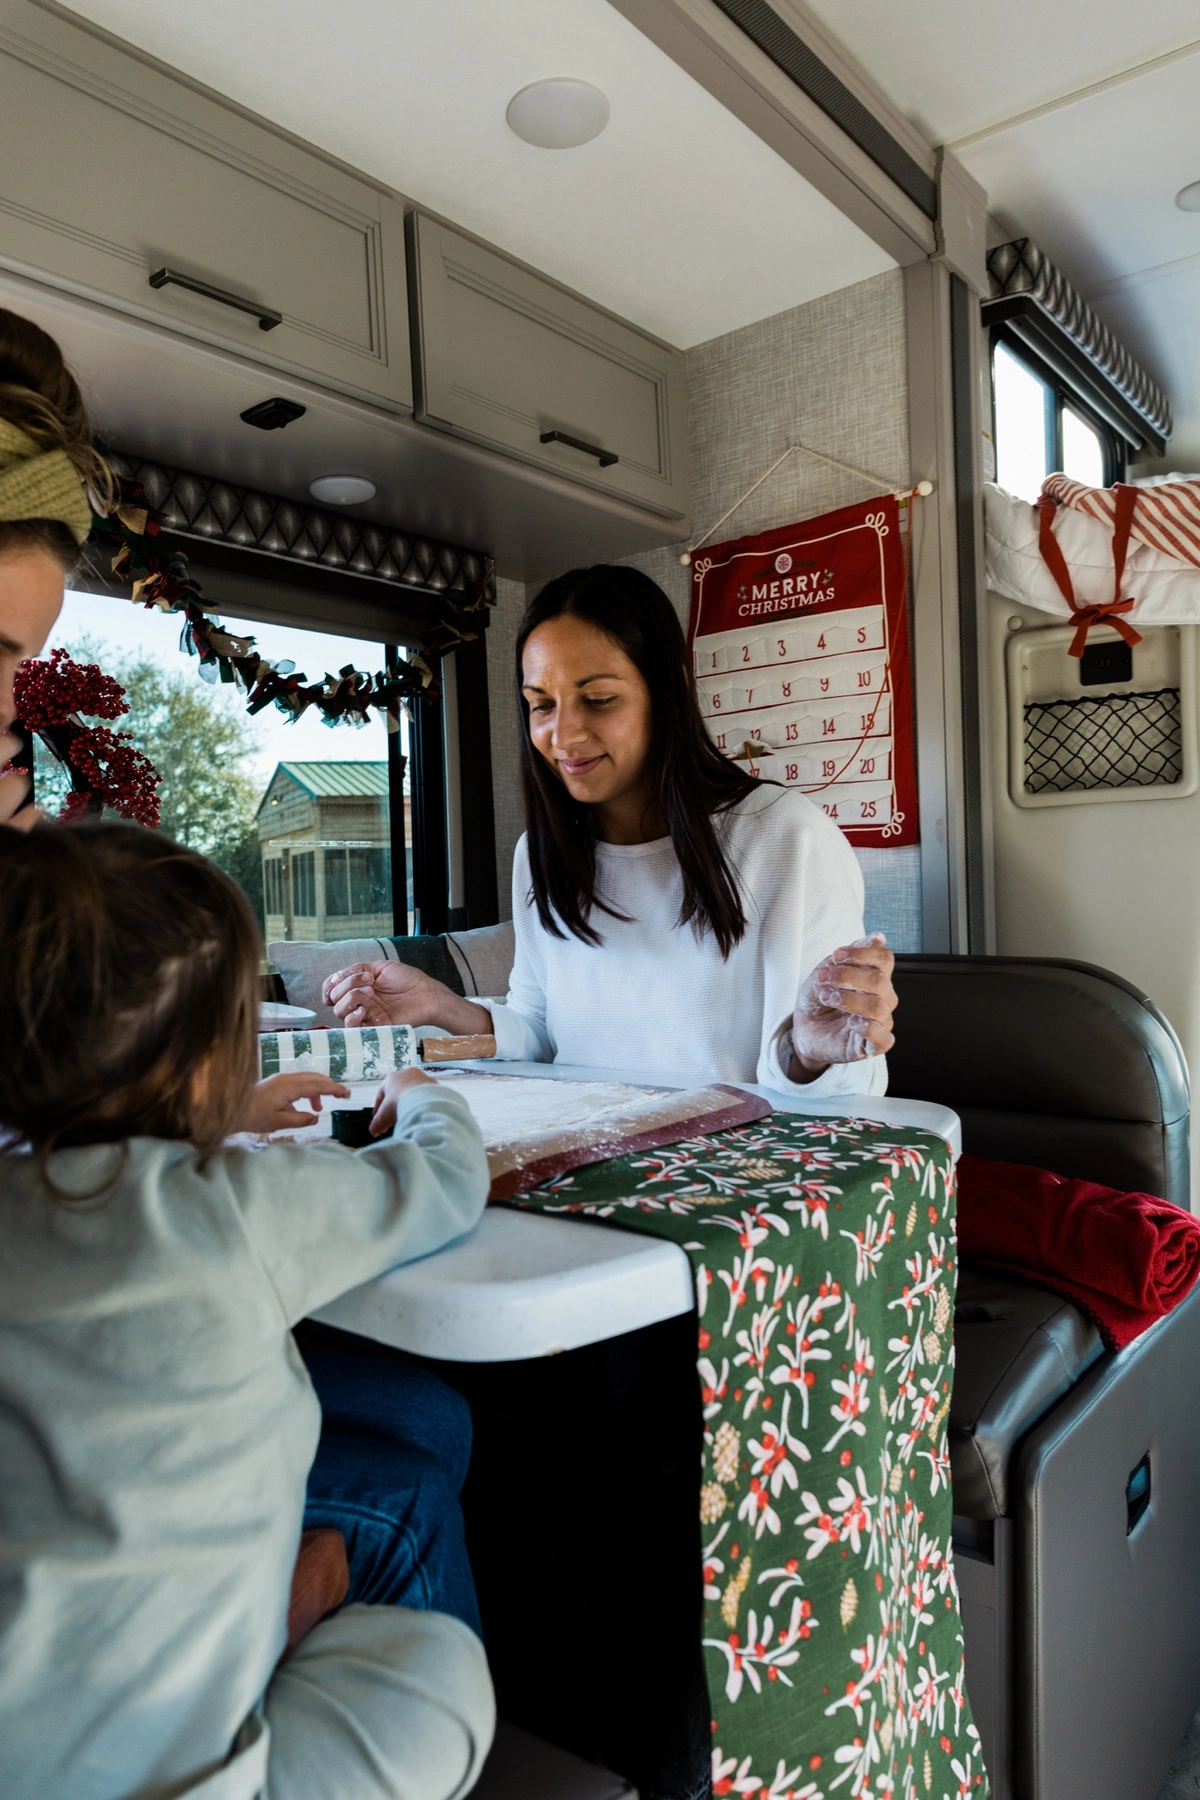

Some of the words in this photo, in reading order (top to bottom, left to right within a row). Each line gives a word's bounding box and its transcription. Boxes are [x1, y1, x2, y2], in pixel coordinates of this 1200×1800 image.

[752, 571, 821, 601] MERRY
[738, 587, 835, 617] CHRISTMAS
[711, 652, 717, 668] 1
[742, 646, 750, 662] 2
[778, 640, 786, 656] 3
[817, 633, 827, 650] 4
[857, 627, 867, 643] 5
[712, 694, 721, 709] 6
[782, 681, 791, 697] 8
[857, 671, 871, 688] 10
[716, 734, 727, 749] 11
[785, 724, 799, 741] 13
[822, 719, 836, 736] 14
[860, 713, 875, 731] 15
[785, 764, 799, 781] 18
[822, 760, 836, 777] 19
[860, 758, 875, 774] 20
[861, 801, 877, 818] 25
